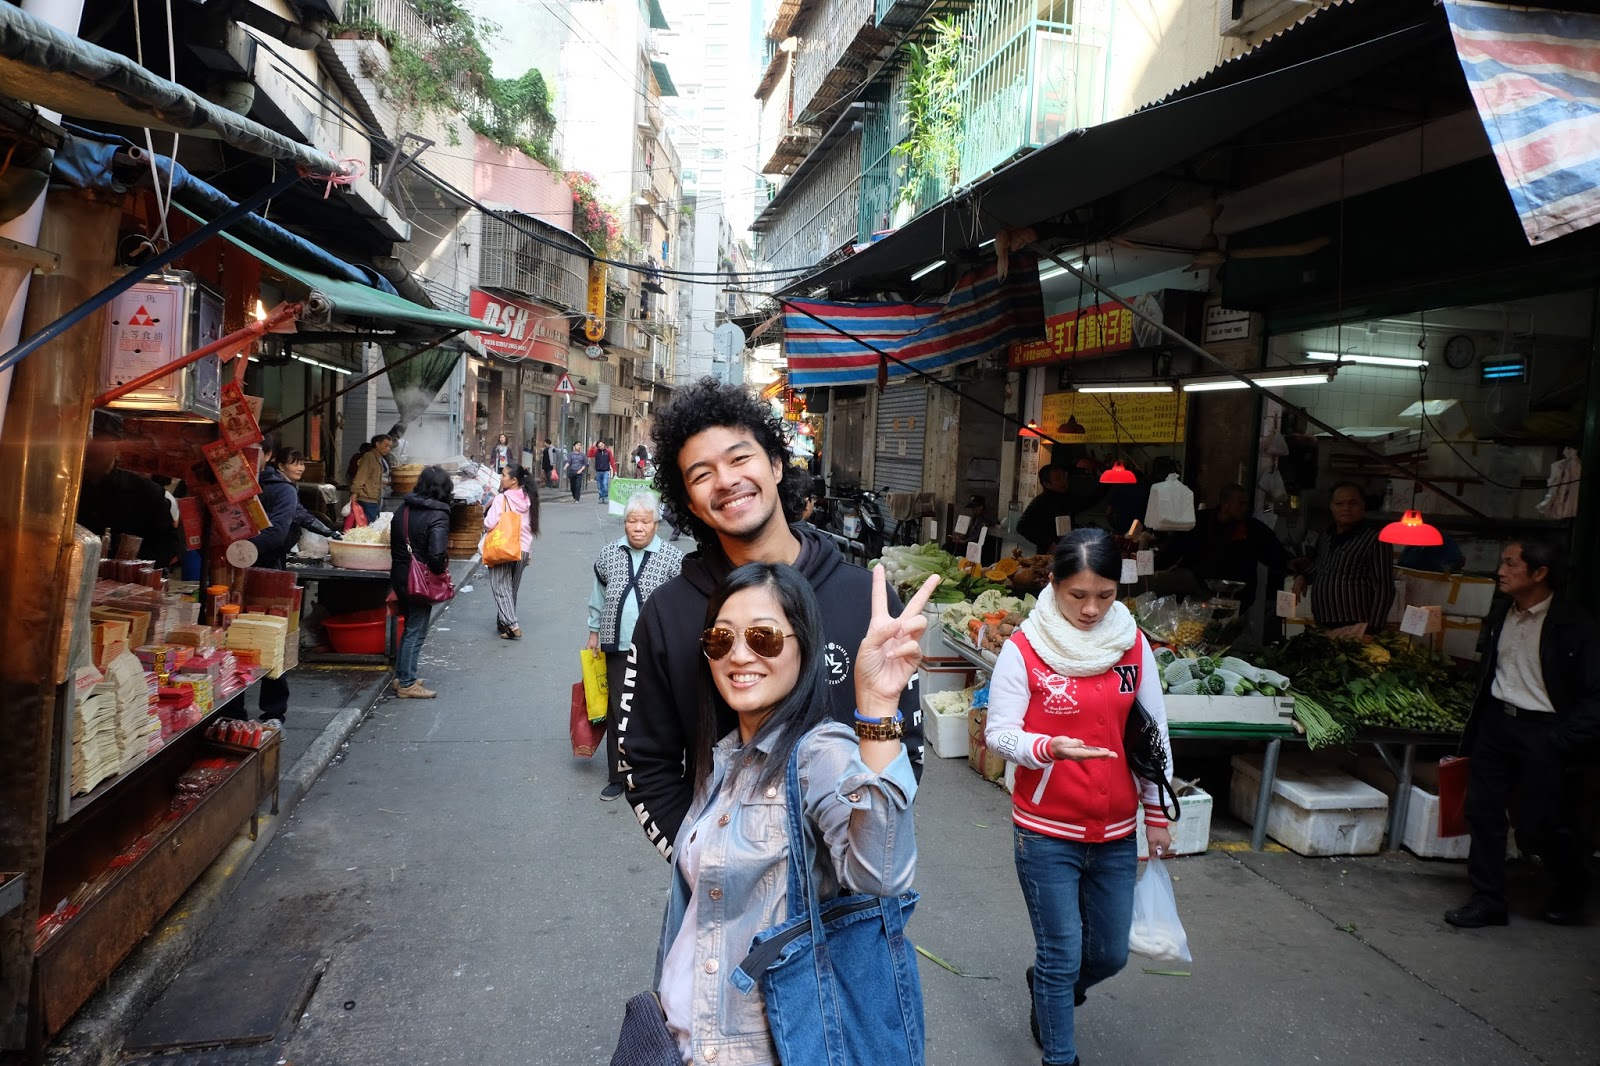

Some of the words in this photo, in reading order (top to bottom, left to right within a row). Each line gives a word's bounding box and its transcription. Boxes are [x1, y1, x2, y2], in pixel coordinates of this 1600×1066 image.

[120, 329, 163, 341] 上等食油
[824, 653, 843, 674] NZ
